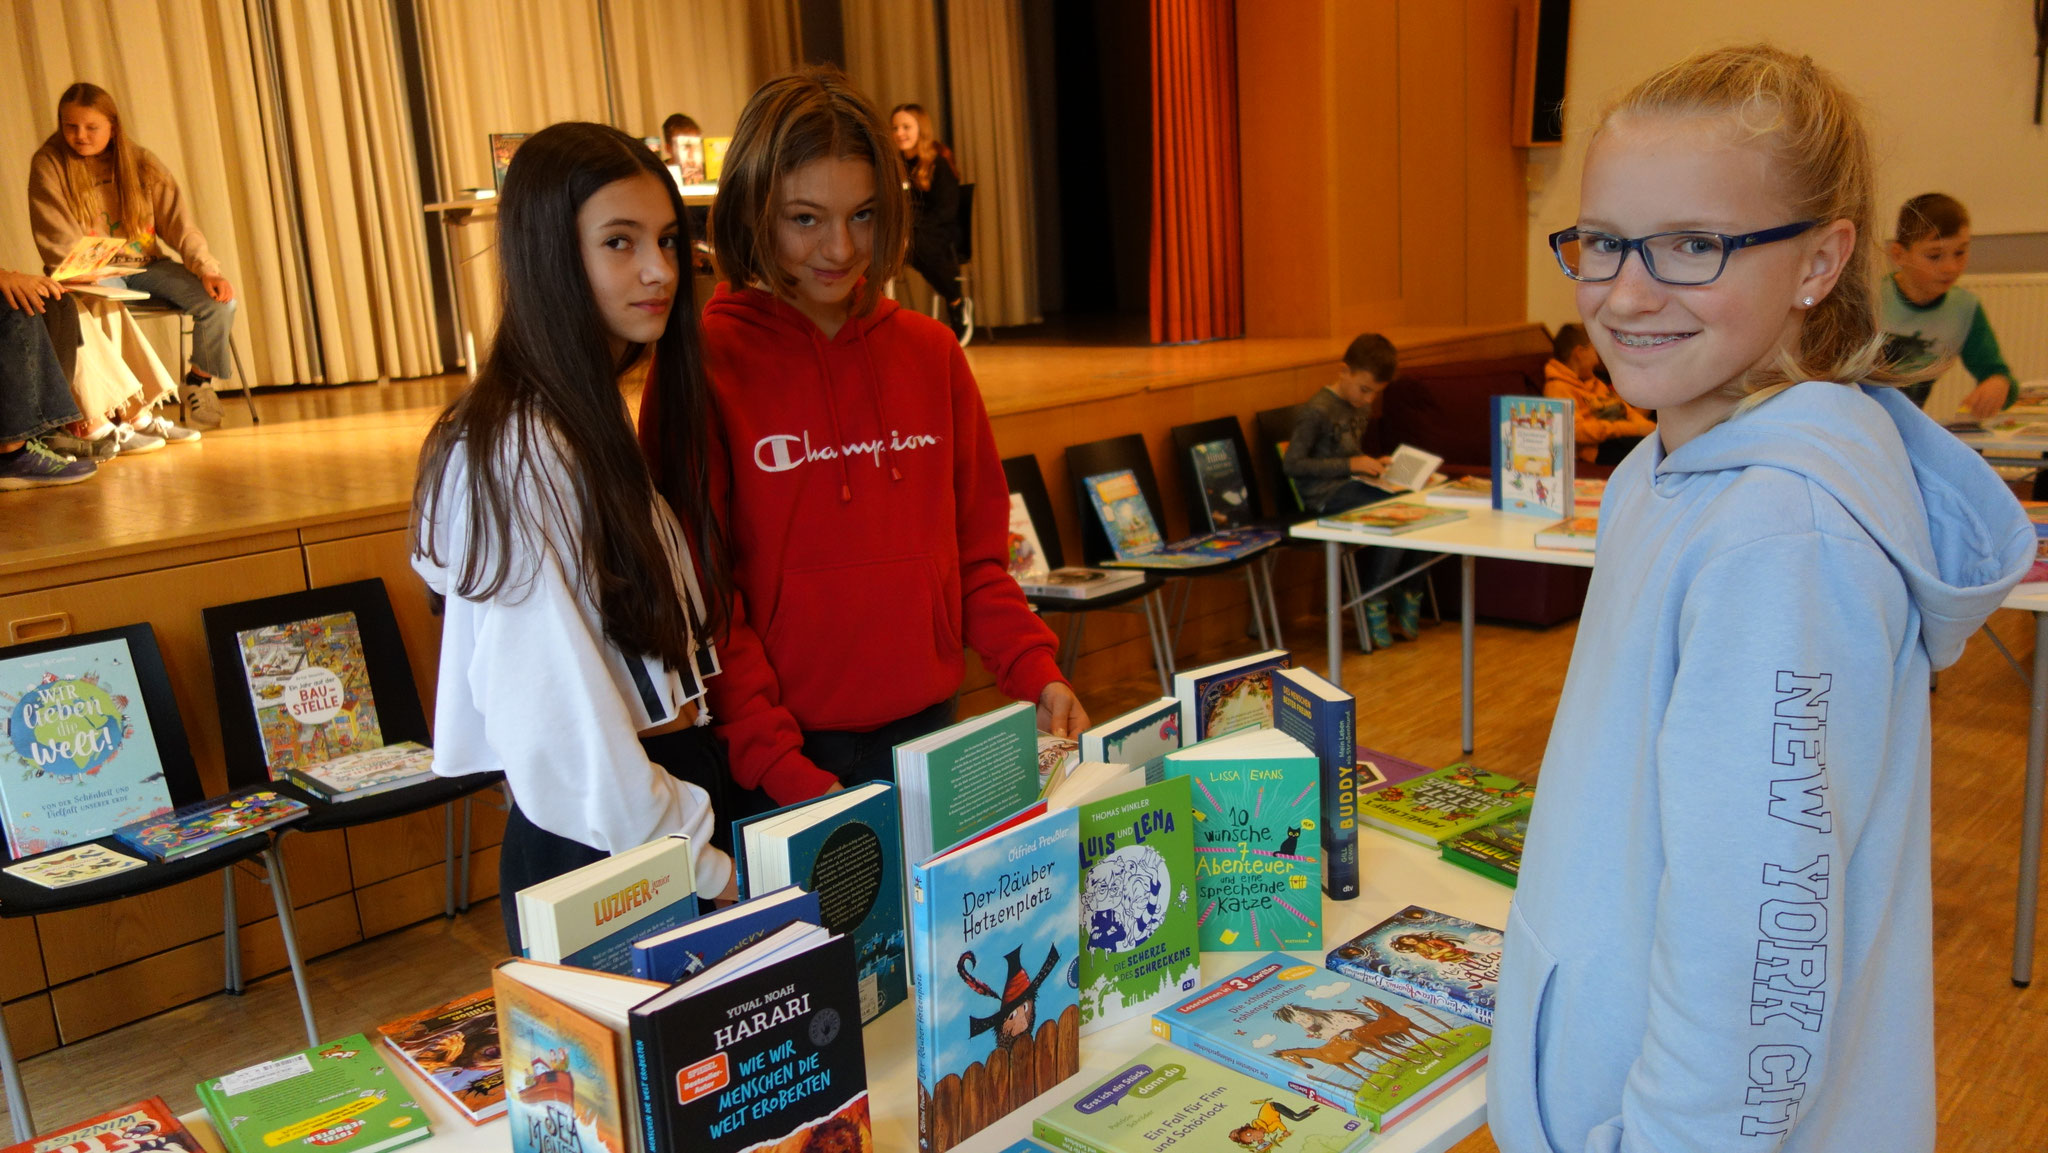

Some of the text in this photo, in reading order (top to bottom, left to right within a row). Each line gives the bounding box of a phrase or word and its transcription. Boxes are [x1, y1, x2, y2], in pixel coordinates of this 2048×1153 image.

[754, 429, 943, 472] Champion
[38, 684, 78, 703] WIR
[292, 695, 340, 716] STELLE
[23, 699, 103, 729] lieben
[1766, 669, 1832, 834] NEW
[1210, 769, 1284, 783] LISSA EVANS
[1092, 799, 1150, 822] THOMAS WINKLER
[1339, 766, 1354, 829] BUDDY
[1413, 798, 1456, 813] DAS
[1229, 806, 1249, 828] 10
[1363, 800, 1446, 829] MINECRAFT
[1008, 827, 1070, 863] Otfried Preußler
[1079, 808, 1175, 870] LUIS UND LENA
[1238, 842, 1249, 861] 7
[1195, 856, 1294, 877] Abenteuer
[1220, 873, 1263, 884] und eine
[593, 878, 653, 927] LUZIFER
[963, 861, 1056, 917] Der Räuber
[1200, 881, 1286, 899] sprechende
[1342, 885, 1354, 893] dtv
[963, 887, 1053, 943] Hotzenplotz
[1113, 942, 1167, 973] DIE SCHERZE
[1750, 854, 1829, 1032] YORK
[1120, 946, 1191, 982] DES SCHRECKENS
[726, 983, 796, 1019] YUVAL NOAH
[1228, 982, 1286, 1015] Die schönsten
[1230, 979, 1249, 991] 3
[713, 993, 812, 1051] HARARI
[738, 1039, 797, 1078] WIE WIR
[718, 1052, 820, 1113] MENSCHEN DIE
[1082, 1097, 1101, 1111] Erst
[1100, 1090, 1114, 1101] ich
[1112, 1082, 1125, 1093] ein
[1138, 1066, 1180, 1095] dann du
[709, 1105, 750, 1140] WELT
[1144, 1085, 1228, 1142] Ein Fall für Finn
[1153, 1101, 1229, 1153] und Schörlock
